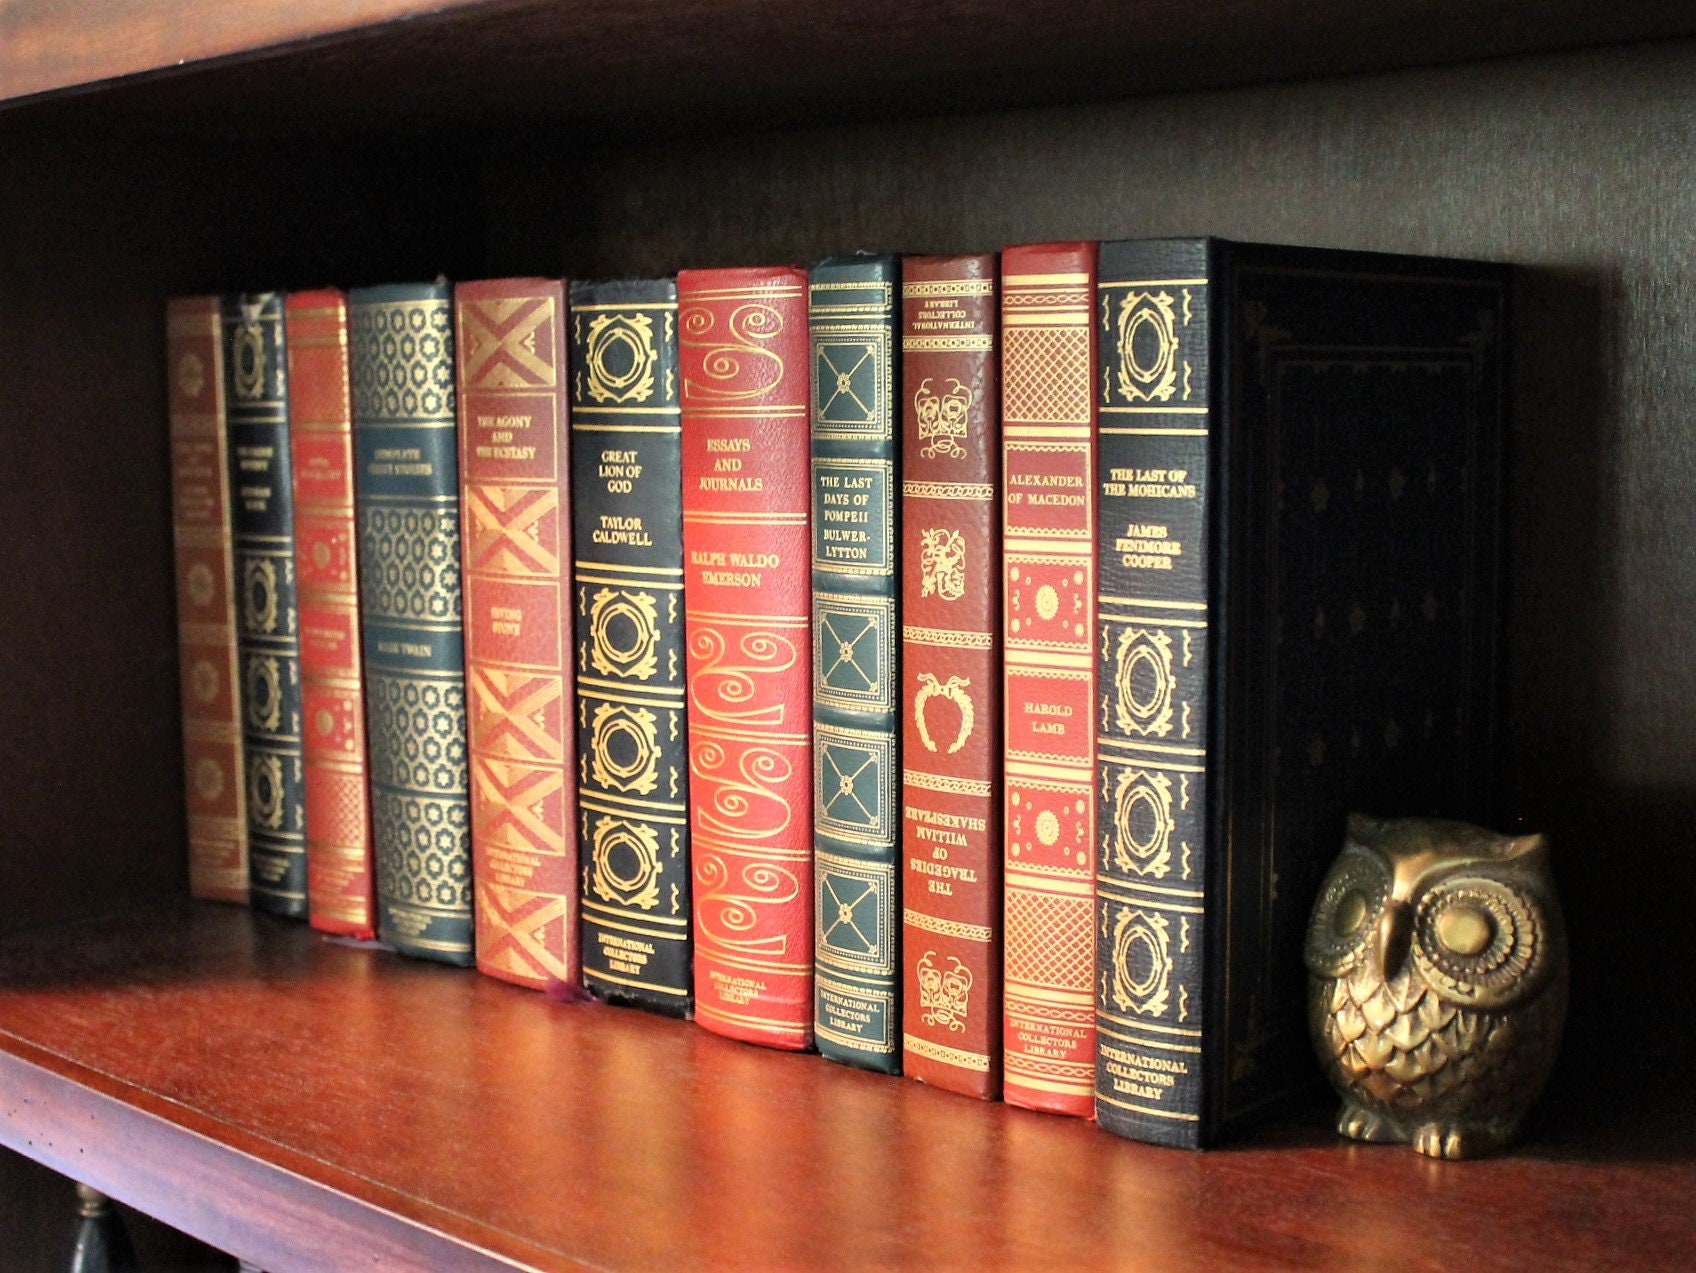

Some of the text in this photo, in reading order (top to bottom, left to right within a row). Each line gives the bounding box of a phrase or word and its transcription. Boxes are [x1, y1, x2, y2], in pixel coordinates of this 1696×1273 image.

[924, 300, 959, 308] LIBRARY
[918, 310, 967, 319] COLLECTORS
[912, 321, 975, 330] INTERNATIONAL
[496, 415, 532, 428] AGONY
[492, 432, 513, 443] AND
[493, 446, 536, 460] ECSTASY
[707, 439, 751, 452] ESSAYS
[601, 451, 638, 464] GREAT
[599, 464, 642, 479] LION OF
[714, 459, 742, 472] AND
[821, 477, 873, 489] THE LAST
[1009, 474, 1084, 488] ALEXANDER
[1110, 468, 1188, 483] THE LAST OF
[607, 480, 632, 494] GOD
[699, 478, 763, 492] JOURNALS
[1103, 483, 1196, 498] THE MOHICANS
[824, 493, 869, 506] DAYS OF
[1008, 493, 1085, 507] OF MACEDON
[600, 516, 642, 531] TAYLOR
[824, 510, 868, 523] POMPEII
[592, 530, 653, 547] CALDWELL
[823, 529, 871, 543] BULWER-
[1127, 524, 1168, 539] JAMES
[825, 546, 868, 559] LYTTON
[1115, 539, 1182, 556] FENIMORE
[691, 551, 780, 568] RALPH WALDO
[1122, 555, 1173, 570] COOPER
[702, 571, 762, 587] EMERSON
[1024, 702, 1073, 717] HAROLD
[1032, 721, 1066, 735] LAMB
[905, 806, 986, 832] SHAKESPEARE
[916, 825, 968, 847] WILLIAM
[932, 846, 948, 861] OF
[910, 857, 978, 883] TRAGEDIES
[928, 879, 953, 896] THE
[820, 989, 880, 1013] INTERNATIONAL
[825, 1005, 871, 1023] COLLECTORS
[830, 1017, 863, 1033] LIBRARY
[1010, 1018, 1088, 1039] INTERNATIONAL
[1017, 1031, 1077, 1049] COLLECTORS
[1024, 1044, 1067, 1058] LIBRARY
[1100, 1043, 1188, 1074] INTERNATIONAL
[1106, 1061, 1175, 1087] COLLECTORS
[1113, 1078, 1163, 1101] LIBRARY
